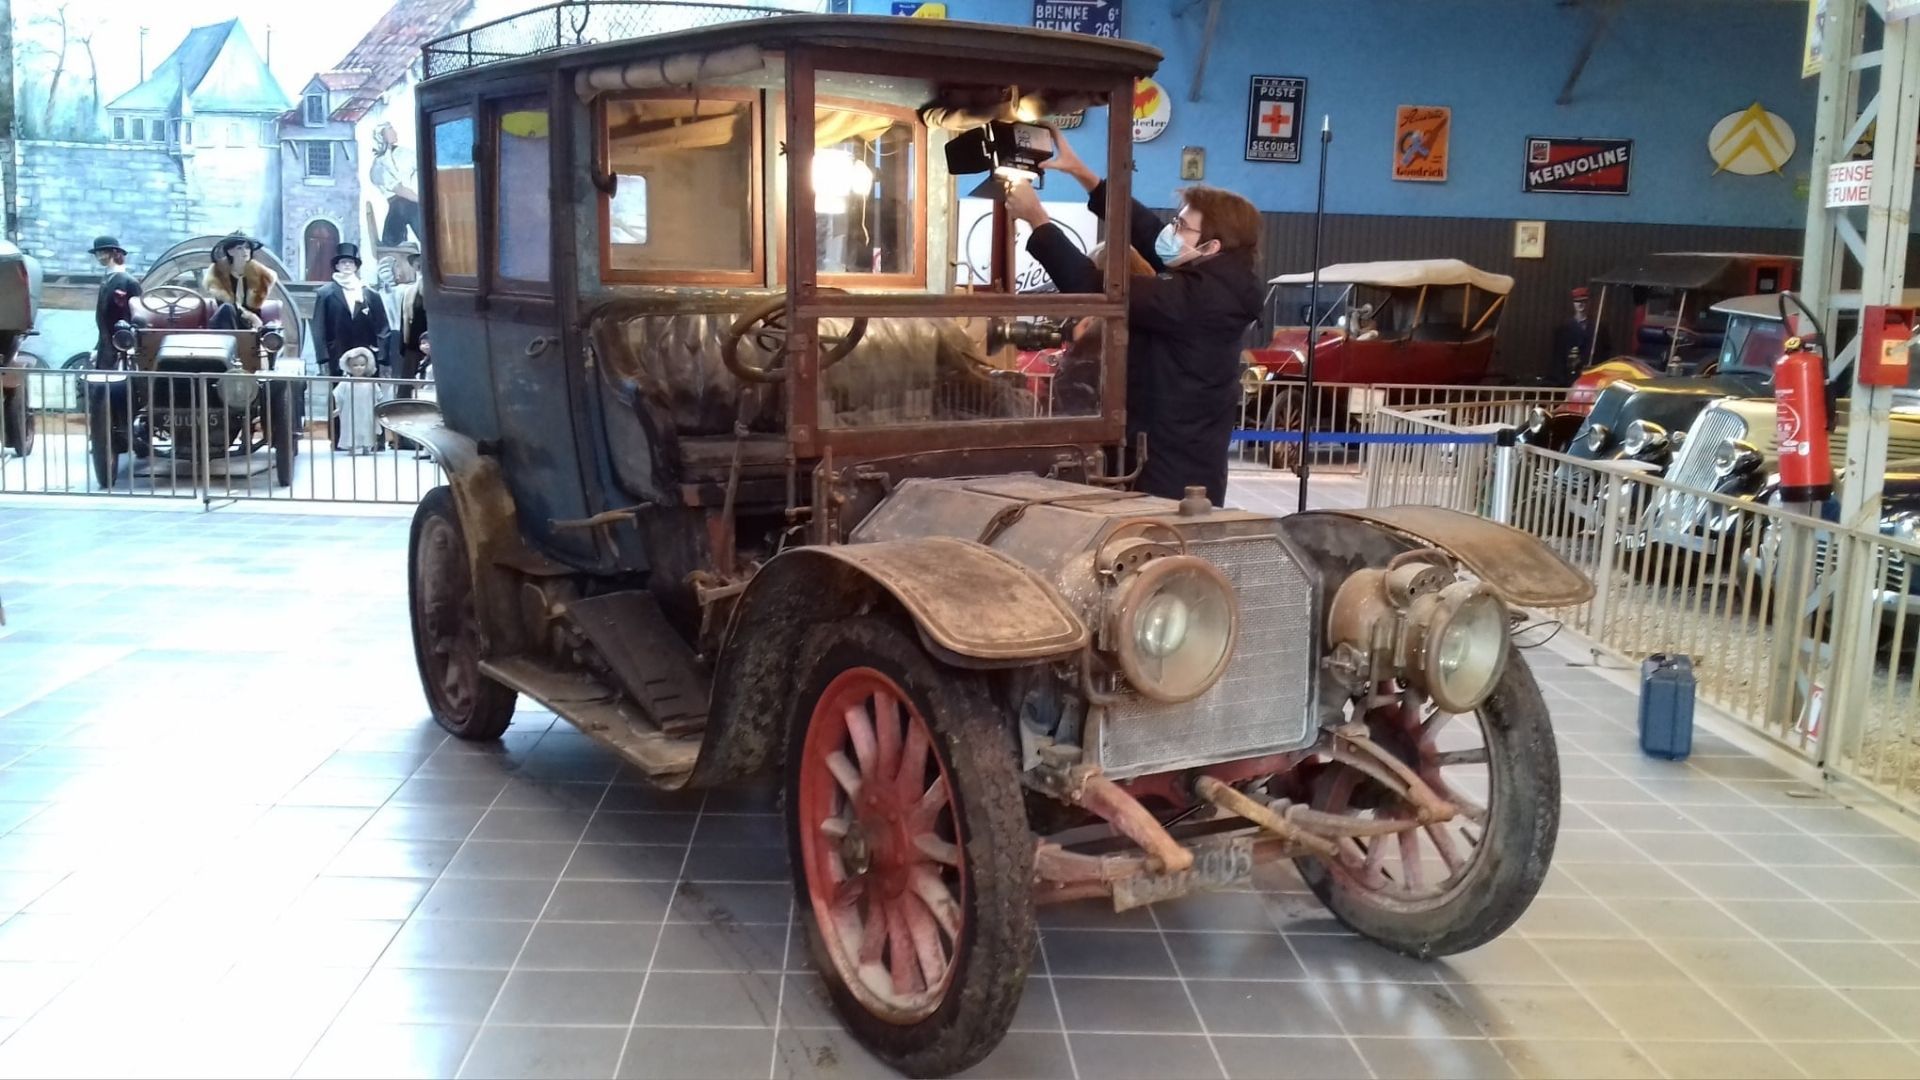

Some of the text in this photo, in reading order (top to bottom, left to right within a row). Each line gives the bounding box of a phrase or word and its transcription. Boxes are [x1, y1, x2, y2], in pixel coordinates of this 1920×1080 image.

[1036, 5, 1089, 20] BRIENNE
[1260, 86, 1296, 98] POSTE
[1251, 140, 1296, 152] SECOURS
[1529, 147, 1628, 186] KERVOLINE
[1830, 165, 1873, 183] EFENSE
[1834, 186, 1872, 202] FUME
